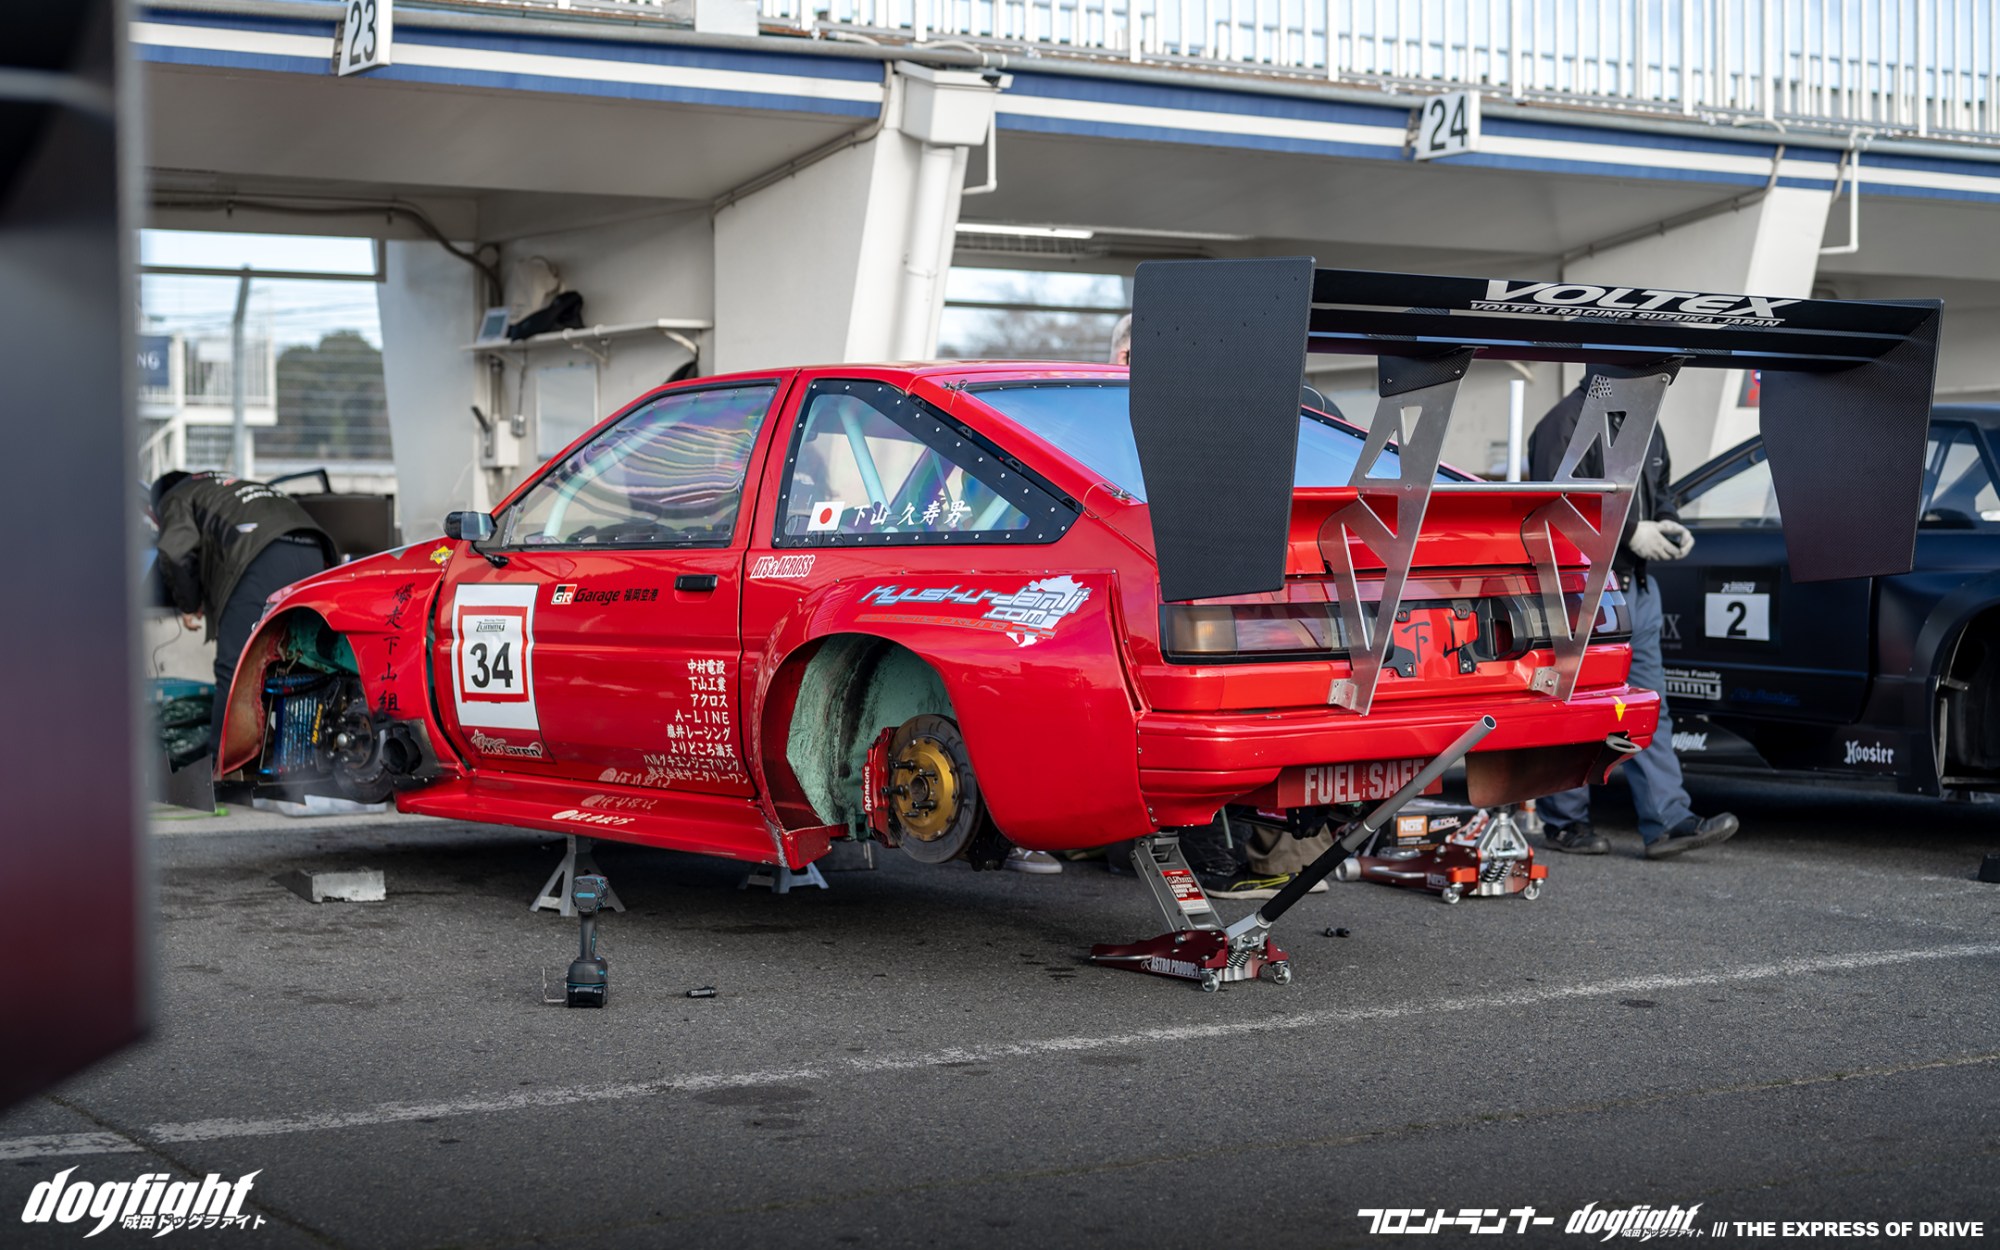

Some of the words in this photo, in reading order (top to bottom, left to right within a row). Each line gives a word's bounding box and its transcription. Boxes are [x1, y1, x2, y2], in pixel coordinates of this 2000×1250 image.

[349, 0, 376, 67] 23
[1430, 95, 1468, 151] 24
[1485, 280, 1803, 319] VOLTEX
[1470, 303, 1556, 315] VOLTEX
[1555, 308, 1634, 319] RACING
[1635, 312, 1712, 324] SUZUKA
[1716, 318, 1780, 328] JAPAN
[574, 588, 621, 606] Garage
[624, 588, 659, 602] 福岡空港
[1726, 601, 1747, 637] 2
[470, 642, 514, 689] 34
[687, 659, 726, 675] 中村電設
[1663, 668, 1690, 678] acing
[1691, 669, 1721, 680] Family
[688, 676, 727, 692] 下山工業
[1664, 680, 1722, 700] mmy
[690, 693, 729, 708] アクロス
[675, 709, 730, 725] A-LINE
[666, 724, 731, 741] 藤井レーシング
[1844, 740, 1894, 764] Hoosier
[1304, 765, 1360, 805] FUEL
[1151, 956, 1170, 972] ASTRO
[1171, 960, 1200, 978] PRODUCT
